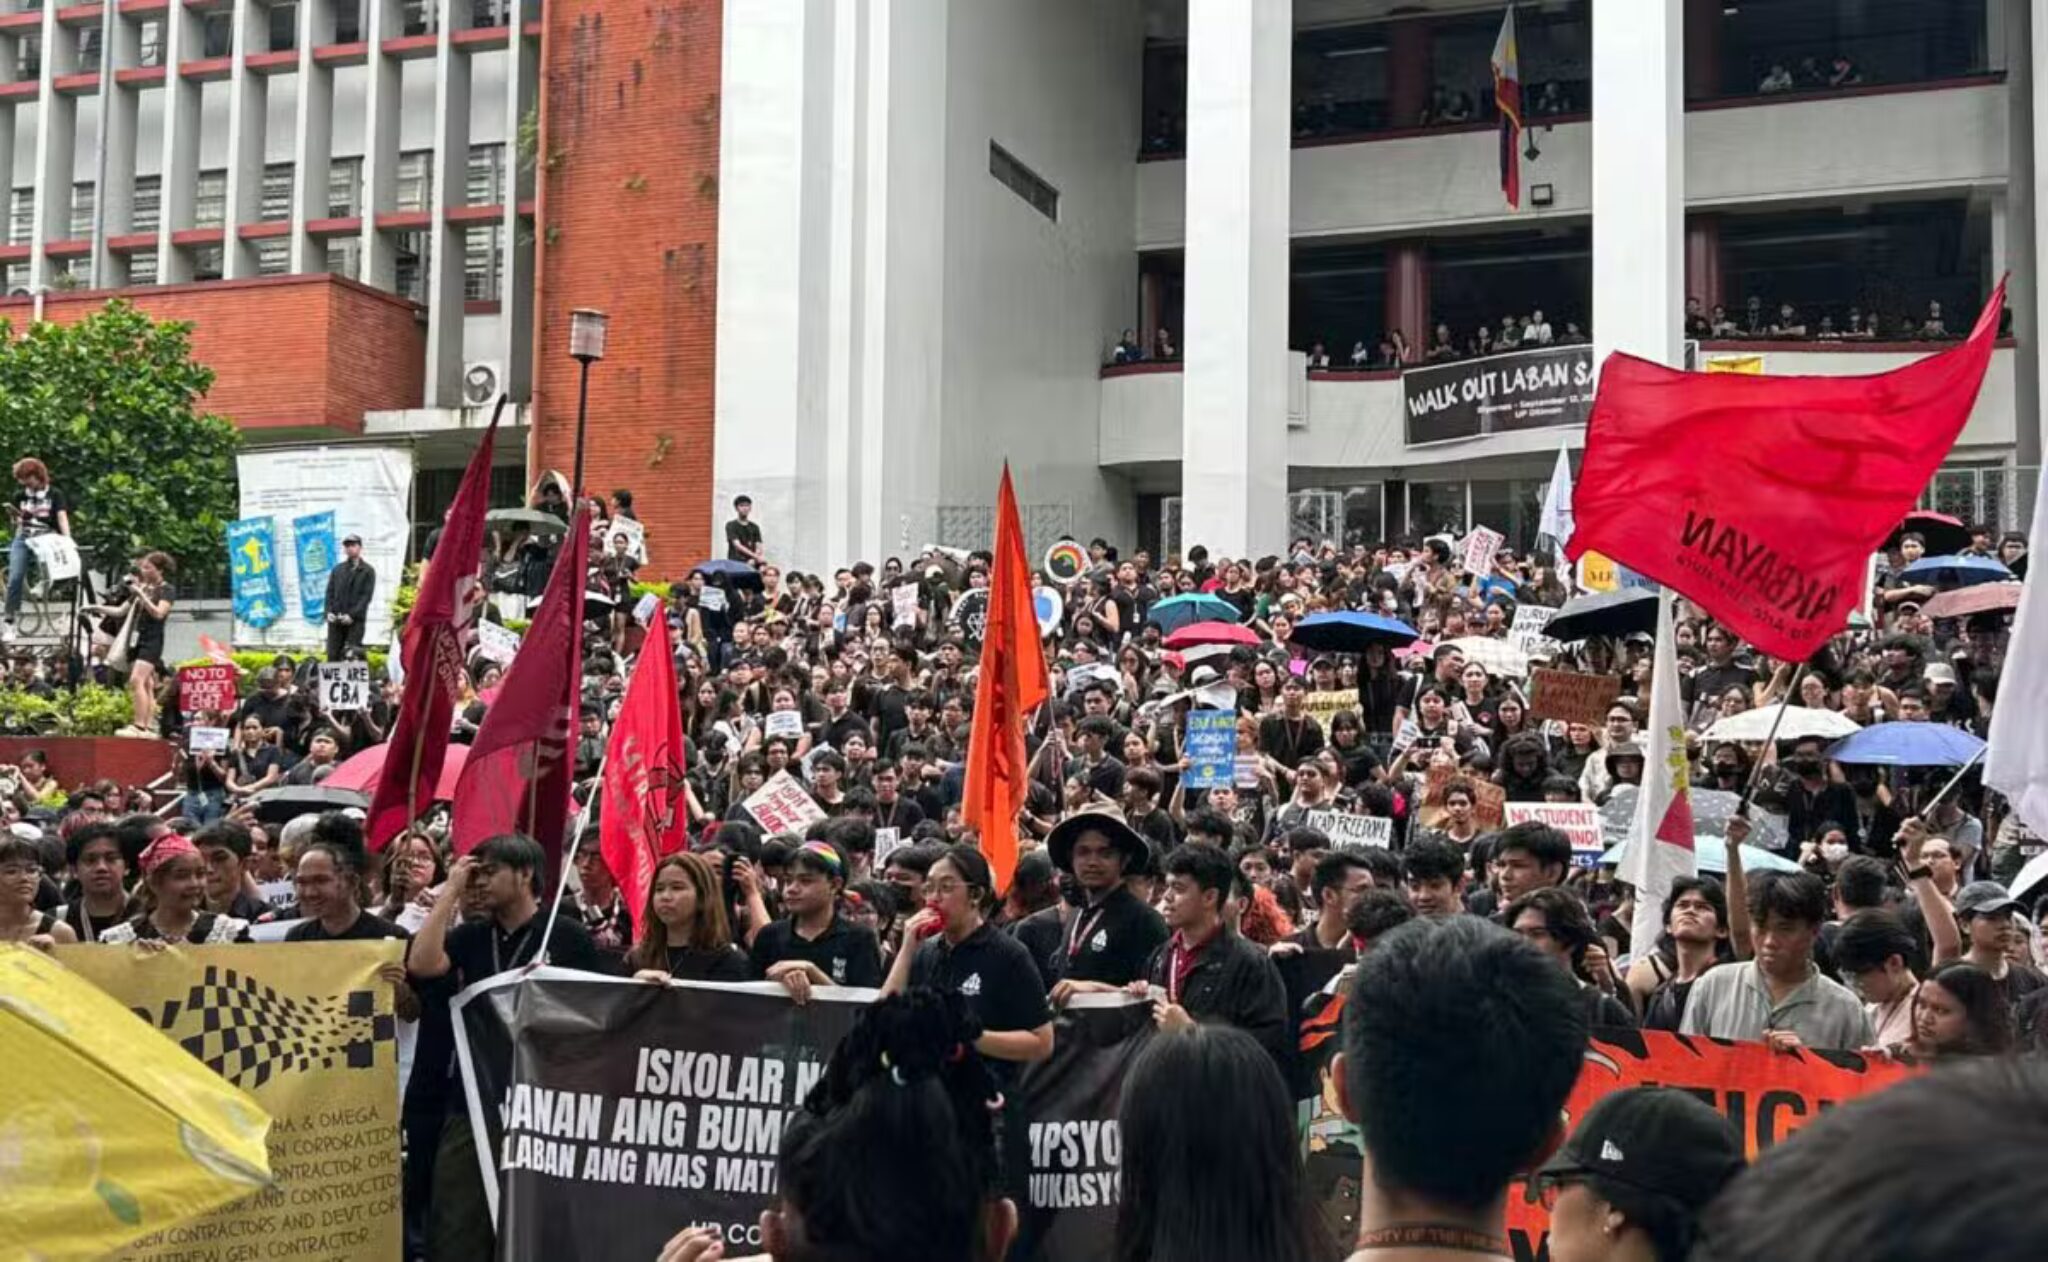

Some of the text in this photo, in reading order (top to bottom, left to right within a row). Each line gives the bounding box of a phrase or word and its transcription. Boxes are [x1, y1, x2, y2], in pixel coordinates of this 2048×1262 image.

[1408, 382, 1458, 416] WALK
[1461, 372, 1497, 401] OUT
[1502, 363, 1568, 394] LABAN
[185, 667, 227, 680] NO TO
[320, 667, 368, 682] WE ARE
[181, 680, 232, 695] BUDGET
[329, 682, 361, 705] CBA
[1510, 808, 1594, 824] NO STUDENT
[1567, 829, 1600, 846] IND!
[635, 1046, 829, 1107] ISKOLAR N
[302, 1115, 314, 1131] &
[319, 1105, 379, 1128] OMEGA
[610, 1096, 688, 1149] ANG
[368, 1149, 397, 1168] OPC
[581, 1145, 638, 1186] ANG
[644, 1151, 708, 1190] MAS
[253, 1186, 285, 1211] AND
[168, 1215, 276, 1245] CONTRACTORS
[282, 1213, 316, 1231] AND
[225, 1242, 260, 1262] GEN
[267, 1226, 370, 1258] CONTRACTOR
